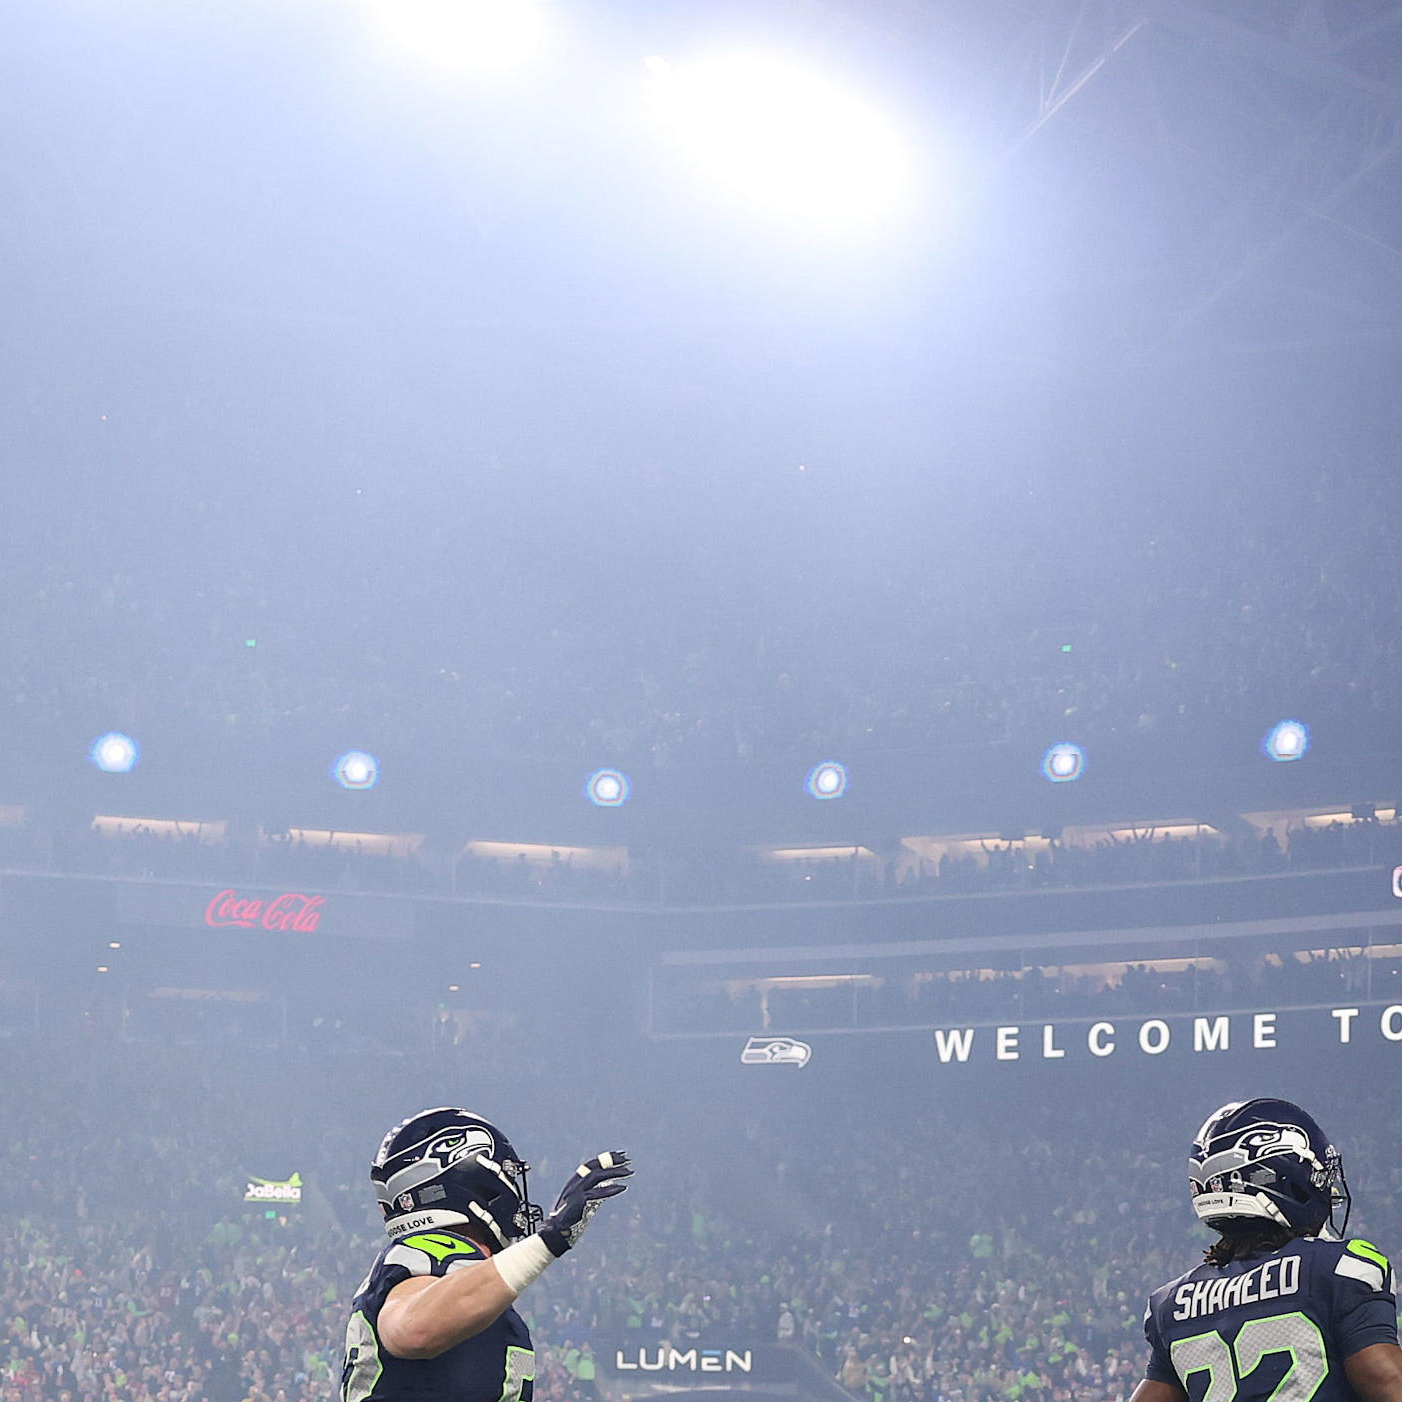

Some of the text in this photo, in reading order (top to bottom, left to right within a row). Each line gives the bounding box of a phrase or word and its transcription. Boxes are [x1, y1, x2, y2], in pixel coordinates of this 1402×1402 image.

[934, 1013, 1277, 1063] WELCOME
[407, 1216, 434, 1230] LOVE
[1172, 1255, 1302, 1321] SHAHEED
[616, 1347, 752, 1373] LUMEN
